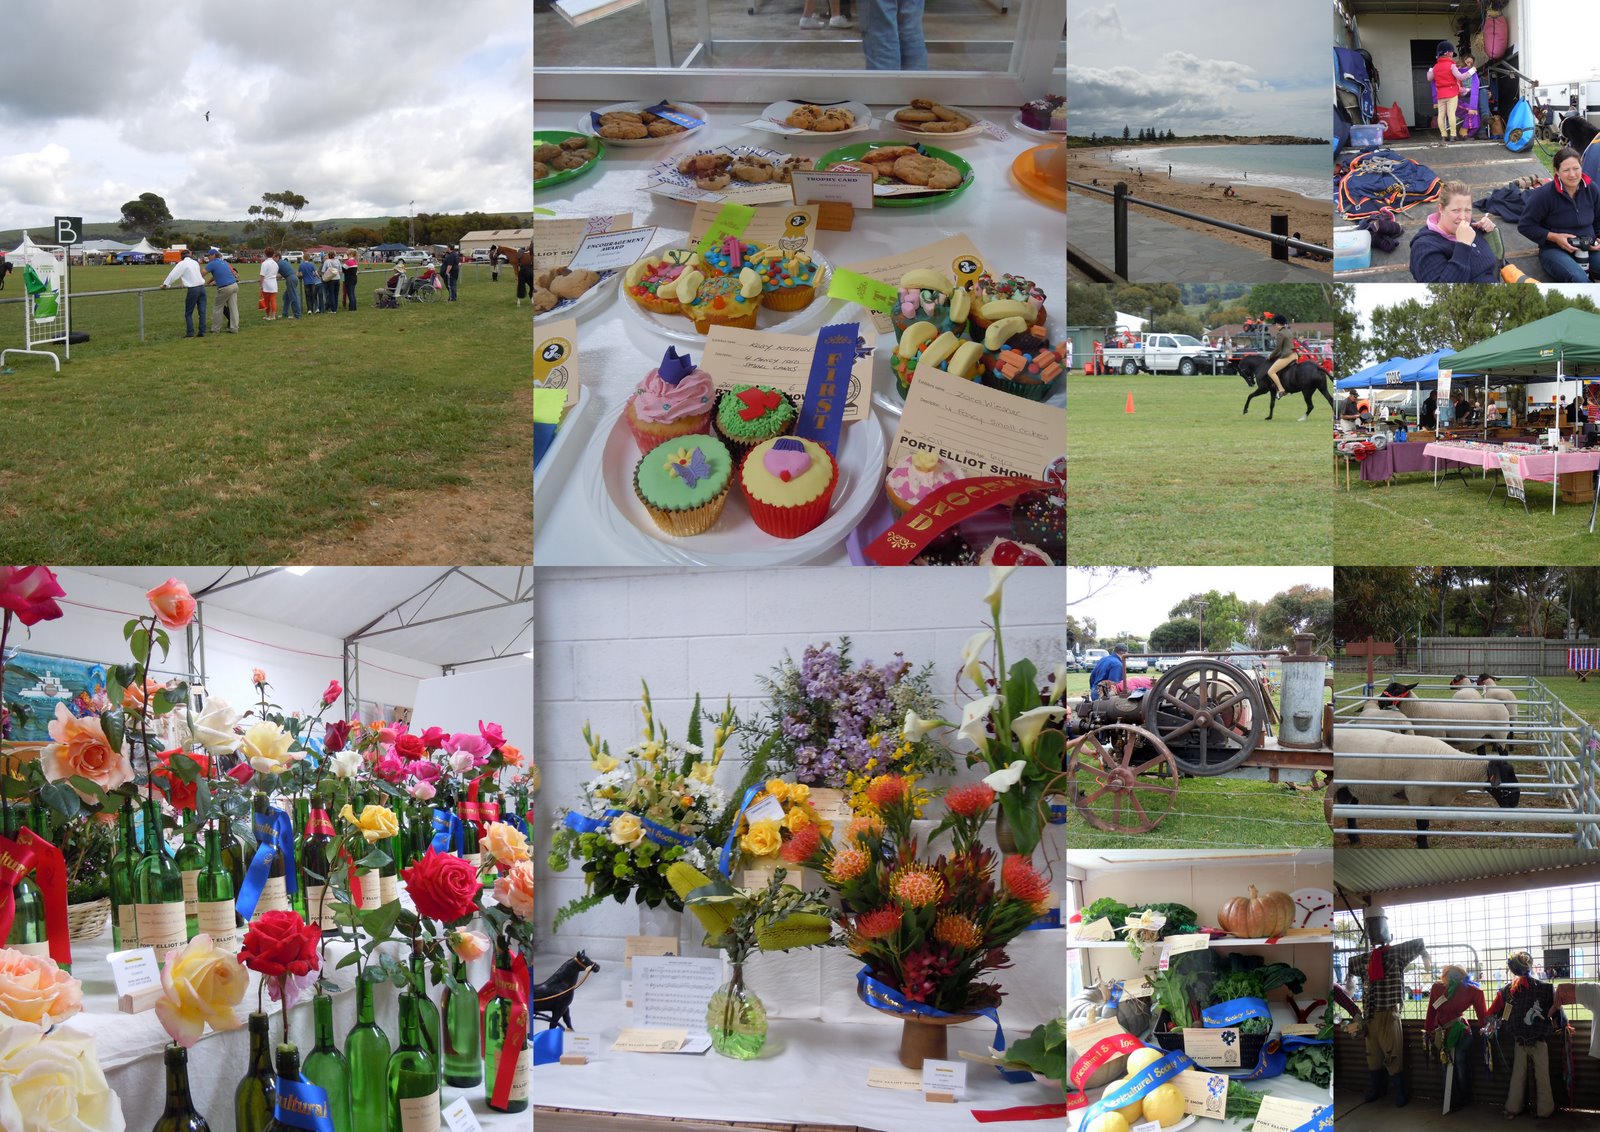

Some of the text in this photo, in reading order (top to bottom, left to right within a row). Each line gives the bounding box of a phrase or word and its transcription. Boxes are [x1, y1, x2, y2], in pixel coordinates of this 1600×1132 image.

[58, 219, 78, 244] B
[586, 237, 646, 250] ENCOURAGEMENT
[601, 244, 625, 252] AWARD
[813, 353, 842, 430] FIRST
[900, 435, 1033, 480] PORT ELLIOT SHOW
[907, 480, 1018, 531] SECOND
